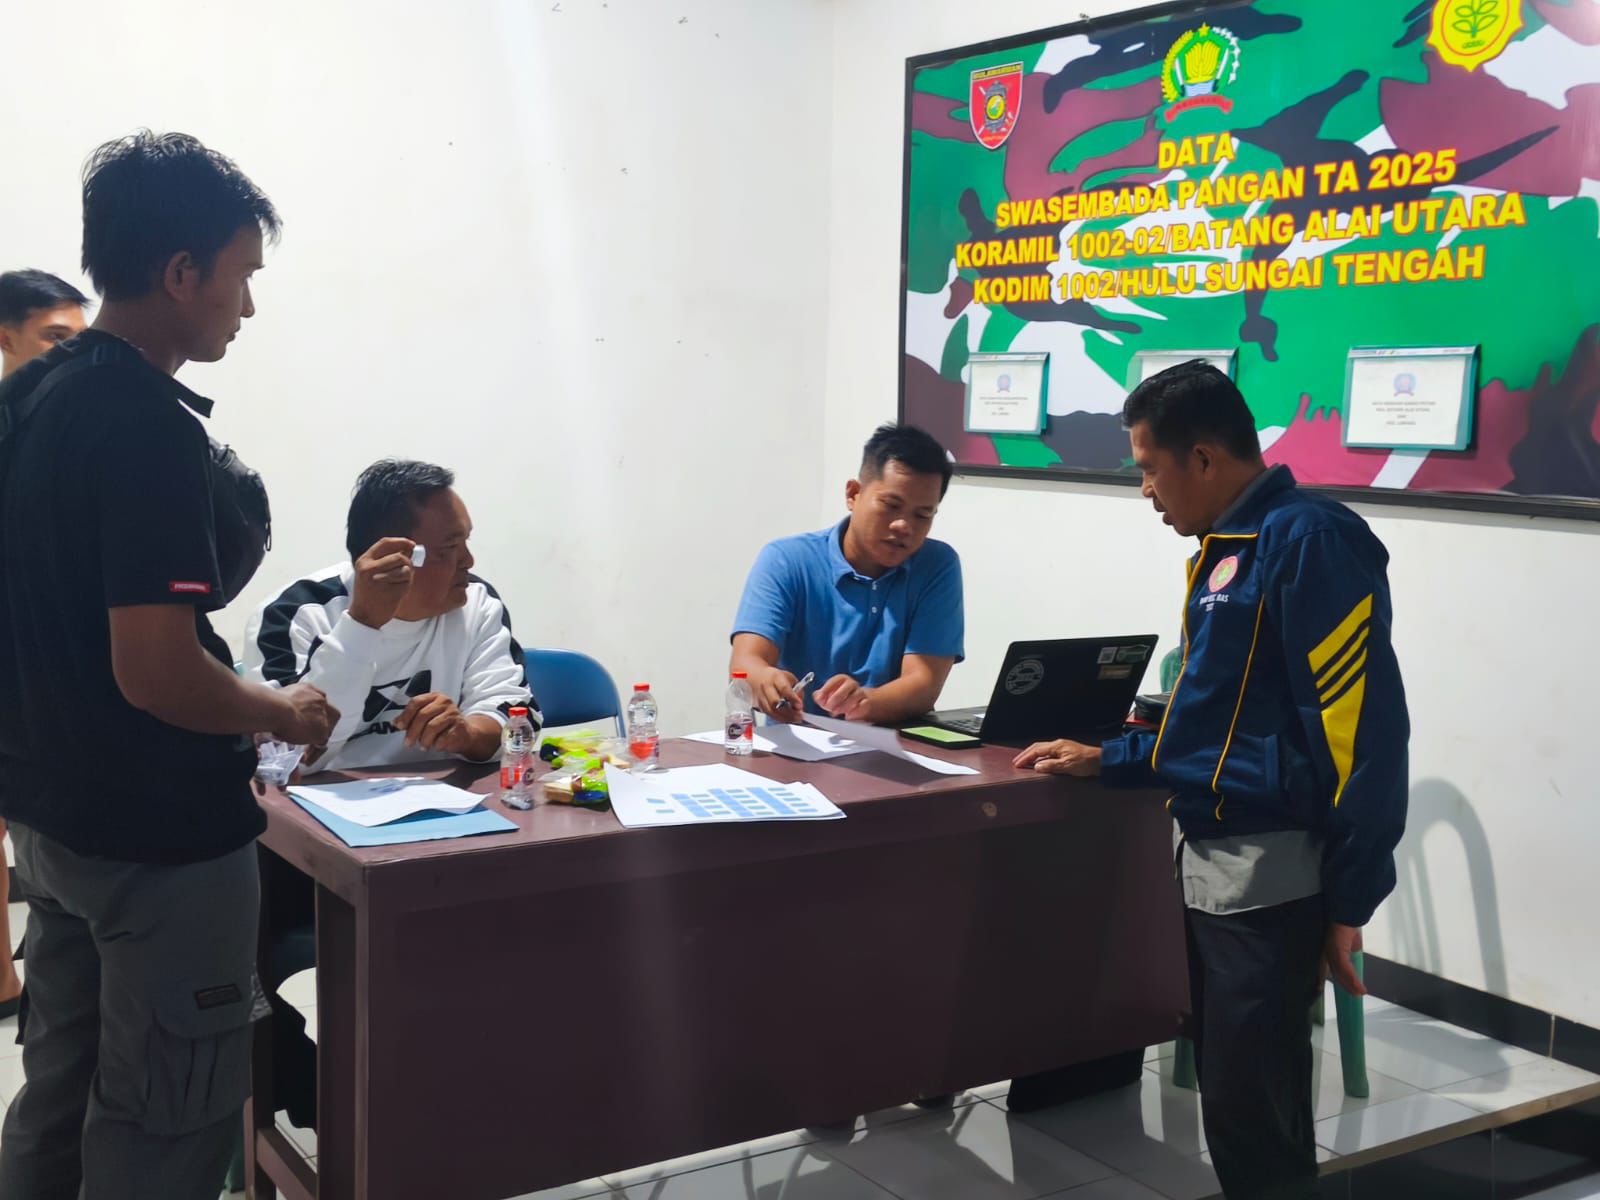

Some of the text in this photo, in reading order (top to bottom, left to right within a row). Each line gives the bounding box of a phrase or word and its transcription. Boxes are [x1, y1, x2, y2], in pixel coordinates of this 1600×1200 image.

[1158, 132, 1235, 169] DATA
[996, 148, 1457, 229] SWASEMBADA PANGAN TA 2025
[955, 191, 1526, 269] KORAMIL 1002-02/BATANG ALAI UTARA
[973, 244, 1485, 304] KODIM 1002/HULU SUNGAI TENGAH
